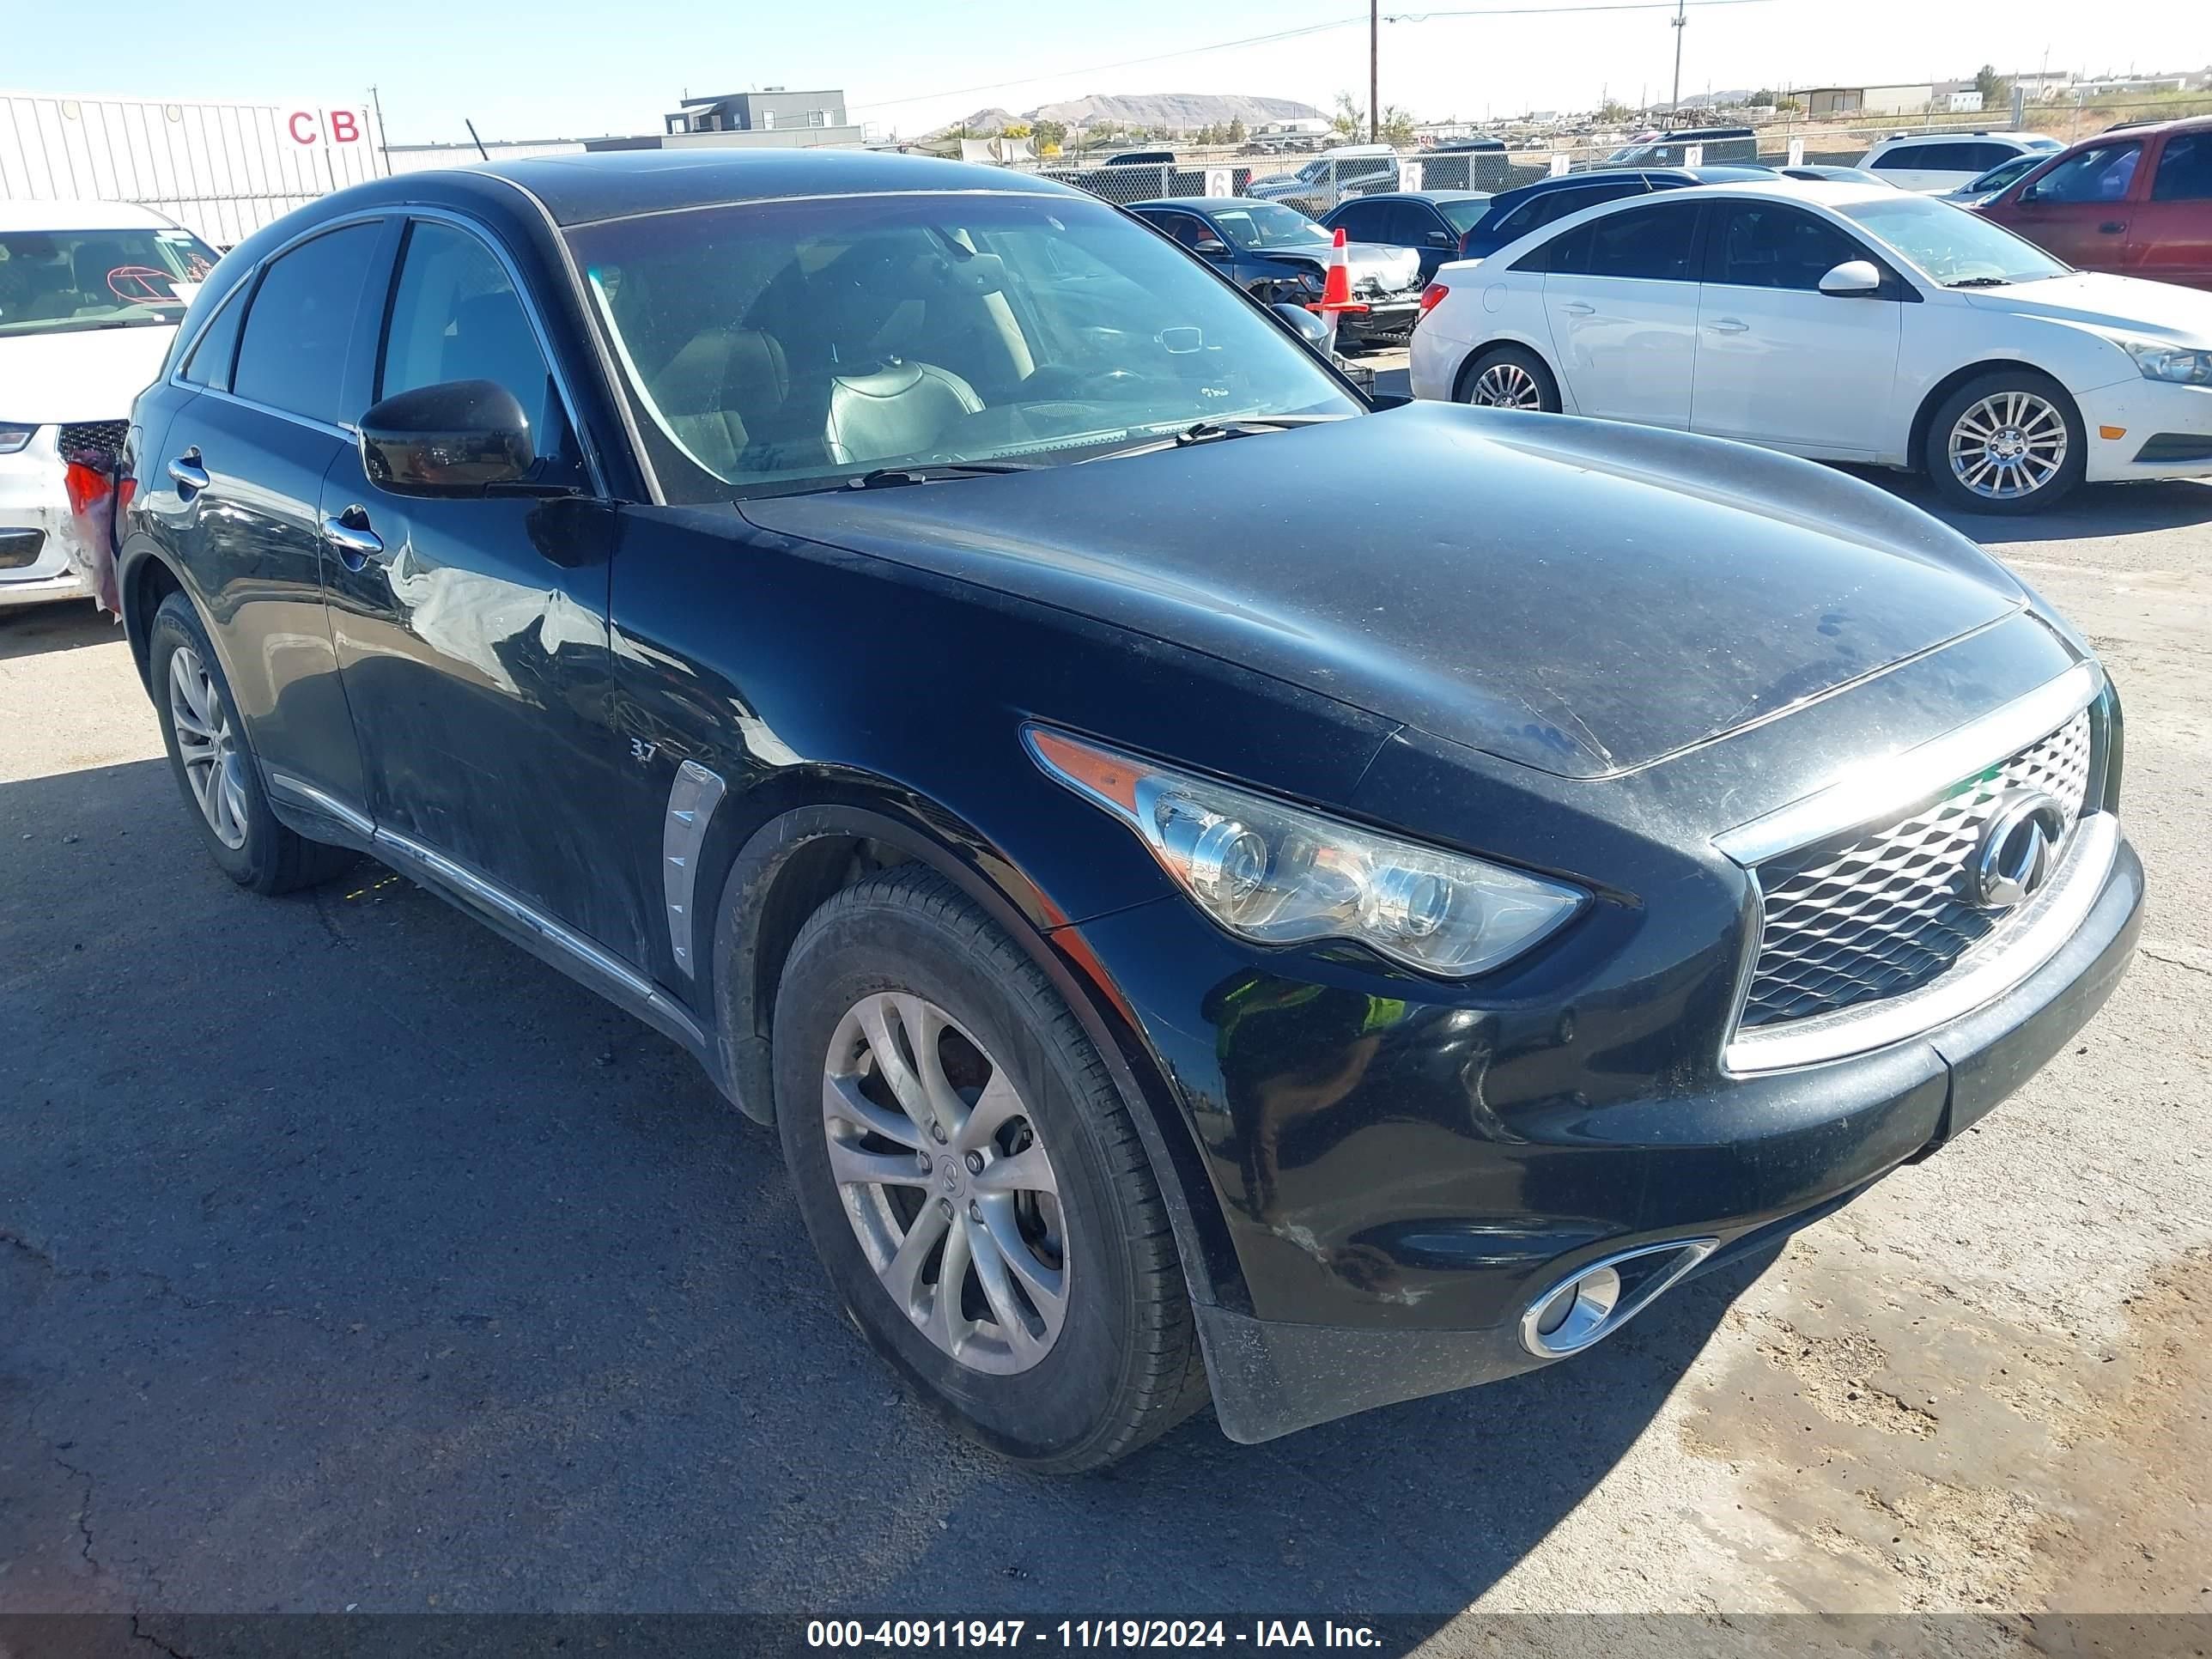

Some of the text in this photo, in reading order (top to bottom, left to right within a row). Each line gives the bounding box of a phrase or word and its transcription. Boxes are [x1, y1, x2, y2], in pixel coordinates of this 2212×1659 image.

[289, 111, 359, 144] C B
[1211, 172, 1225, 197] 6
[1404, 166, 1416, 192] 5
